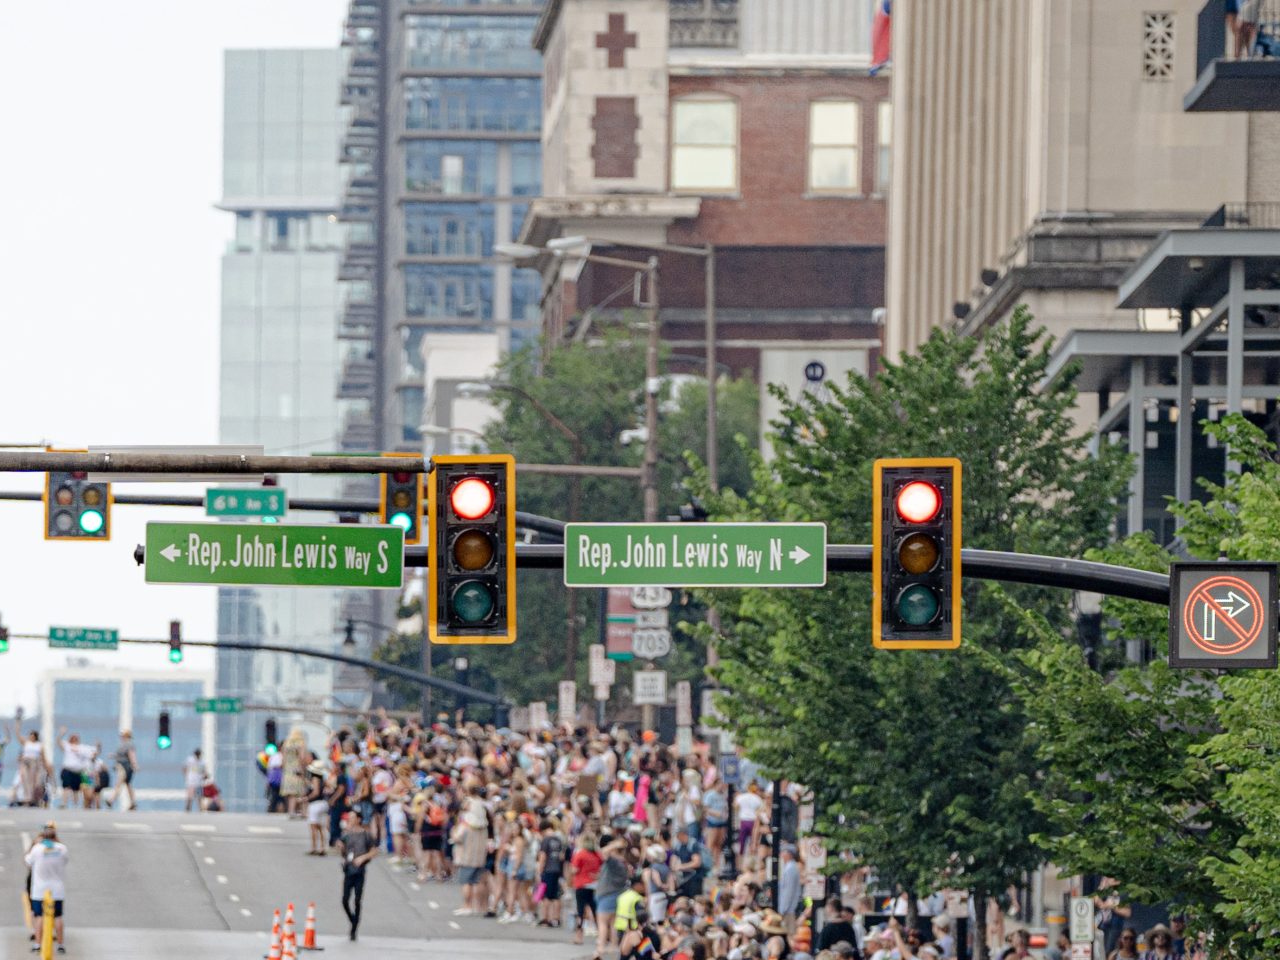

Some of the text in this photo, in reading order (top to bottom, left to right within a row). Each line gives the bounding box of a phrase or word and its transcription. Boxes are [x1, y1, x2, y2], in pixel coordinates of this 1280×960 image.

[188, 533, 389, 575] Rep. John Lewis Way S
[578, 534, 782, 576] Rep. John Lewis Way N
